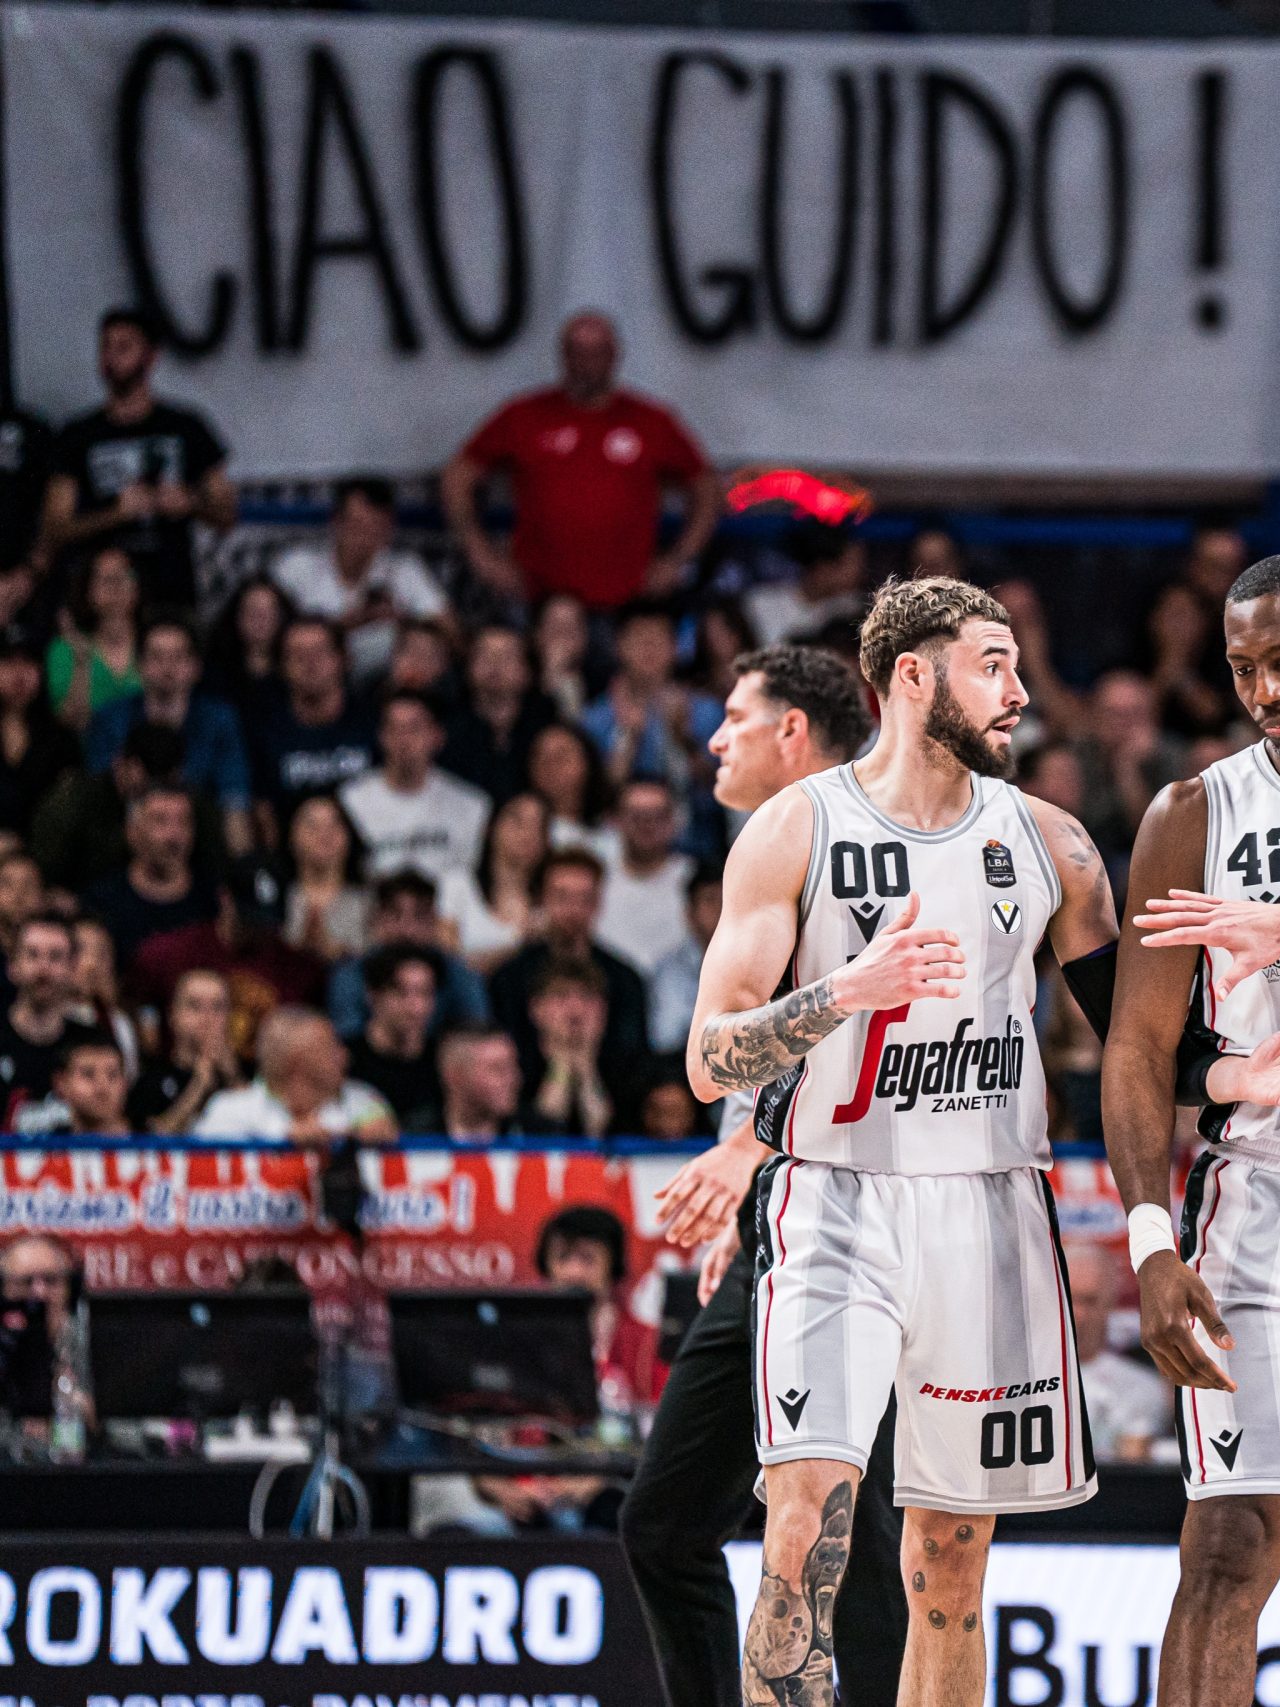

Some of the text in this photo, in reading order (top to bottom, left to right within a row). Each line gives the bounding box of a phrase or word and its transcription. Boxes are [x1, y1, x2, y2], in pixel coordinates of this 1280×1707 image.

[98, 27, 530, 360] CIAO
[830, 841, 911, 899] 00
[987, 858, 1011, 867] LBA
[931, 1094, 1007, 1113] ZANETTI
[919, 1376, 1061, 1402] PENSKECARS
[980, 1404, 1055, 1469] 00
[0, 1565, 605, 1667] OKUADRO
